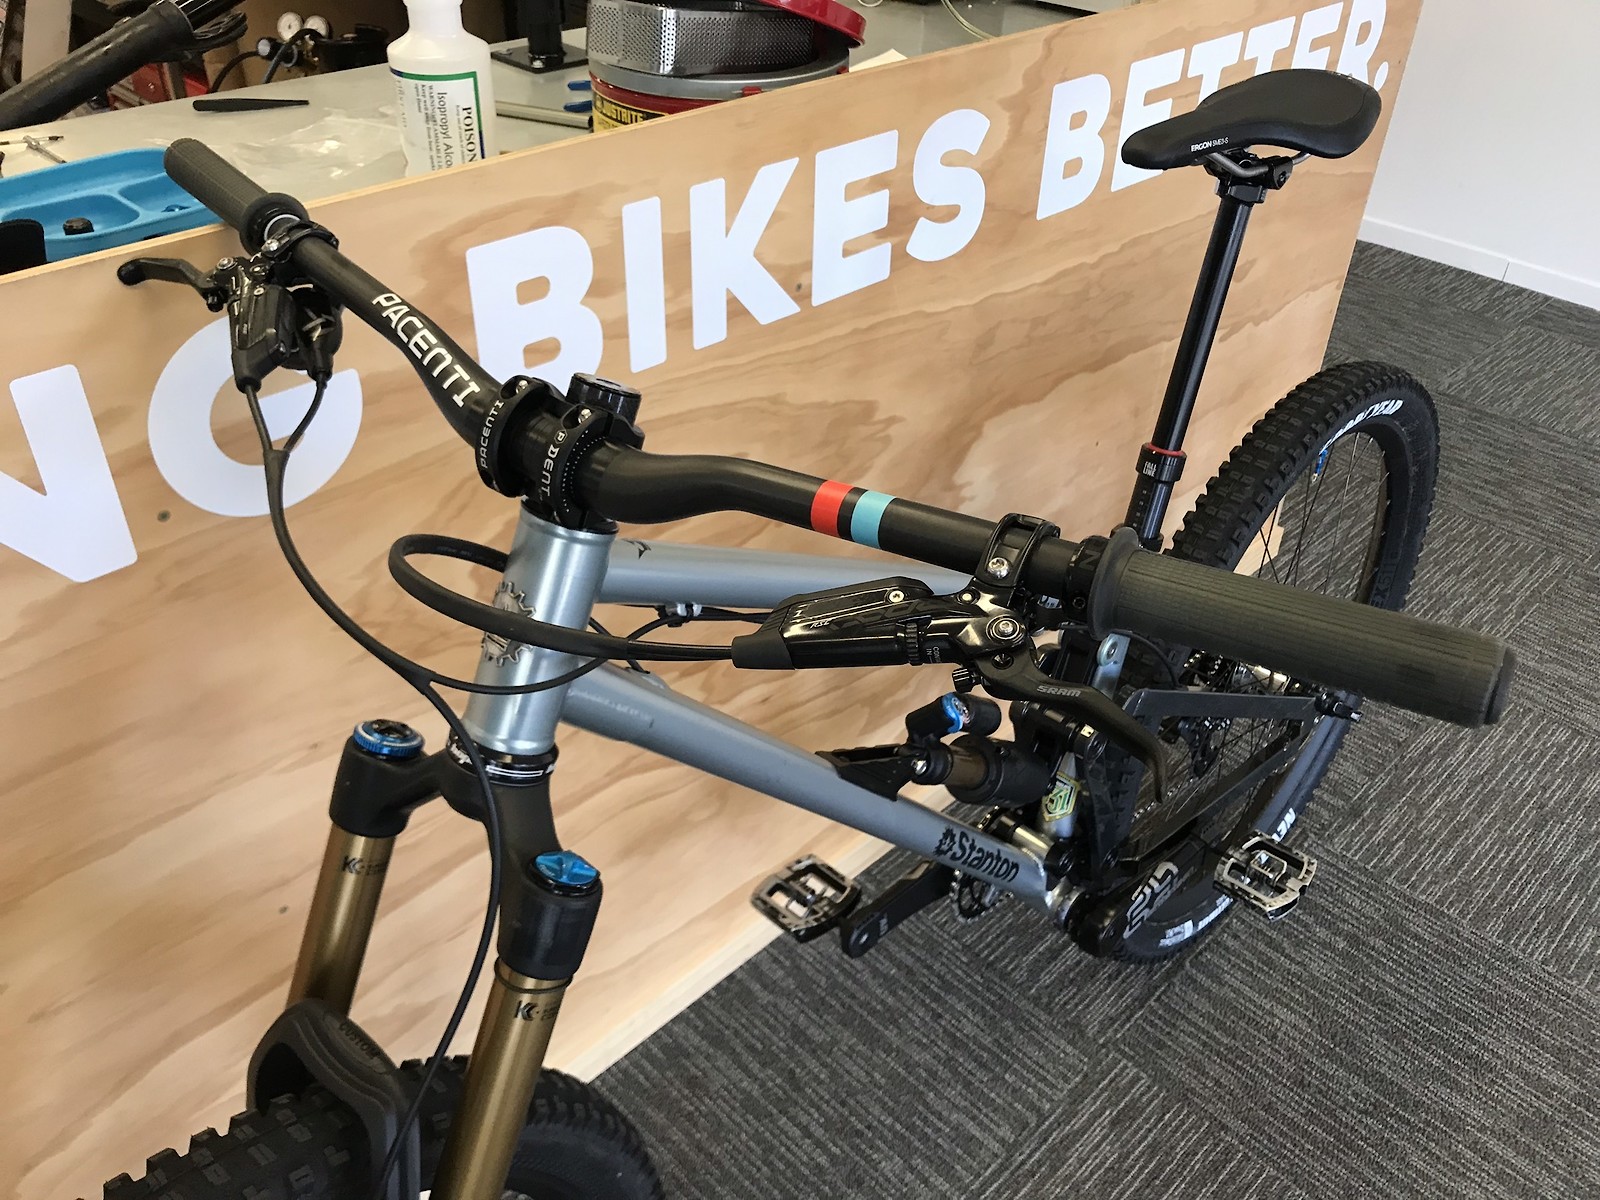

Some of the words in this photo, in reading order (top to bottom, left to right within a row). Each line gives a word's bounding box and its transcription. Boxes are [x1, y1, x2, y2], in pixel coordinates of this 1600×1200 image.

[436, 92, 452, 140] Isopropyl
[462, 107, 478, 162] POISON
[443, 142, 455, 169] Alco
[466, 108, 991, 396] BIKES
[371, 292, 481, 408] PACENTI
[480, 400, 504, 469] PACENTI
[1036, 684, 1082, 697] SRAM
[949, 830, 1020, 883] Stanton
